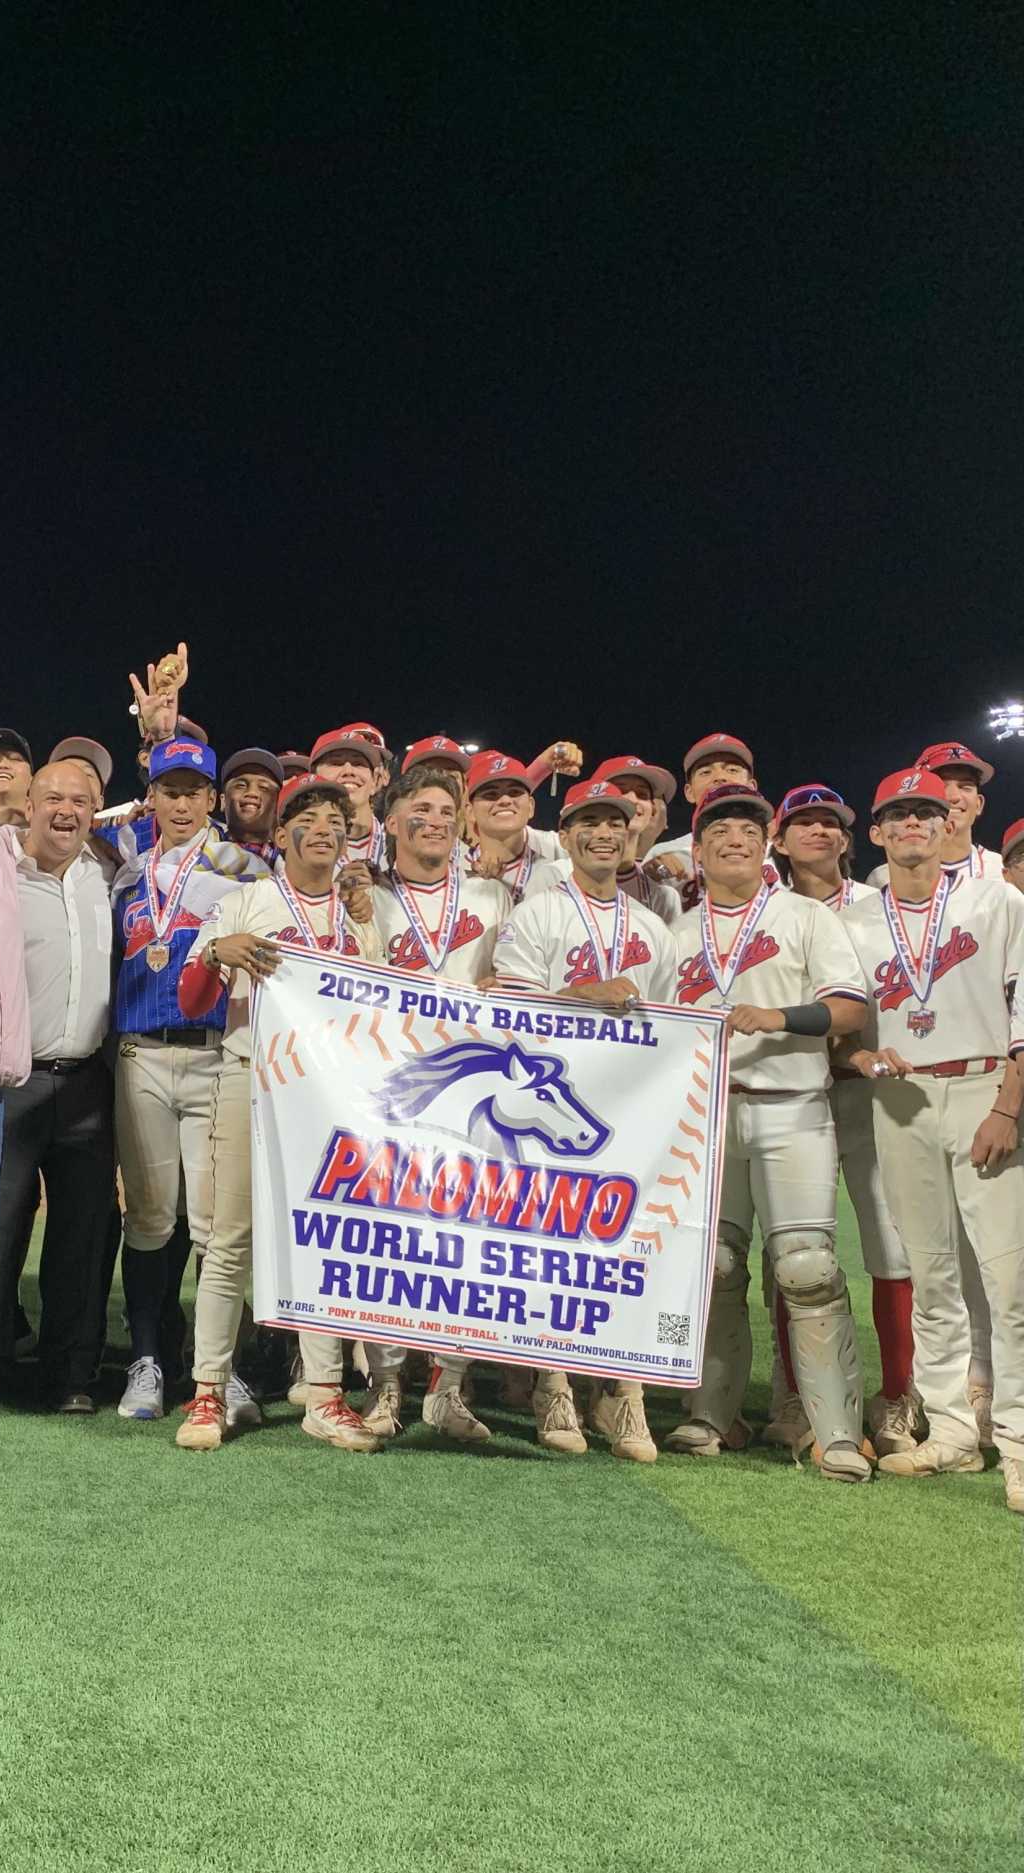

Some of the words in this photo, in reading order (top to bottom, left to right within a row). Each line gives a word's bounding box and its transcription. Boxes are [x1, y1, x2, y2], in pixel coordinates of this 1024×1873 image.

[317, 972, 390, 1009] 2022
[398, 990, 483, 1024] PONY
[492, 1008, 658, 1047] BASEBALL
[315, 1133, 636, 1241] PALOMINO
[292, 1210, 464, 1271] WORLD
[480, 1241, 646, 1297] SERIES
[632, 1241, 652, 1254] TM
[319, 1259, 611, 1336] RUNNER-UP
[328, 1306, 358, 1319] PONY
[360, 1312, 415, 1329] BASEBALL
[418, 1320, 441, 1332] AND
[445, 1324, 498, 1341] SOFTBALL
[512, 1334, 692, 1368] WWW.PALOMINOWORLDSERIES.ORG
